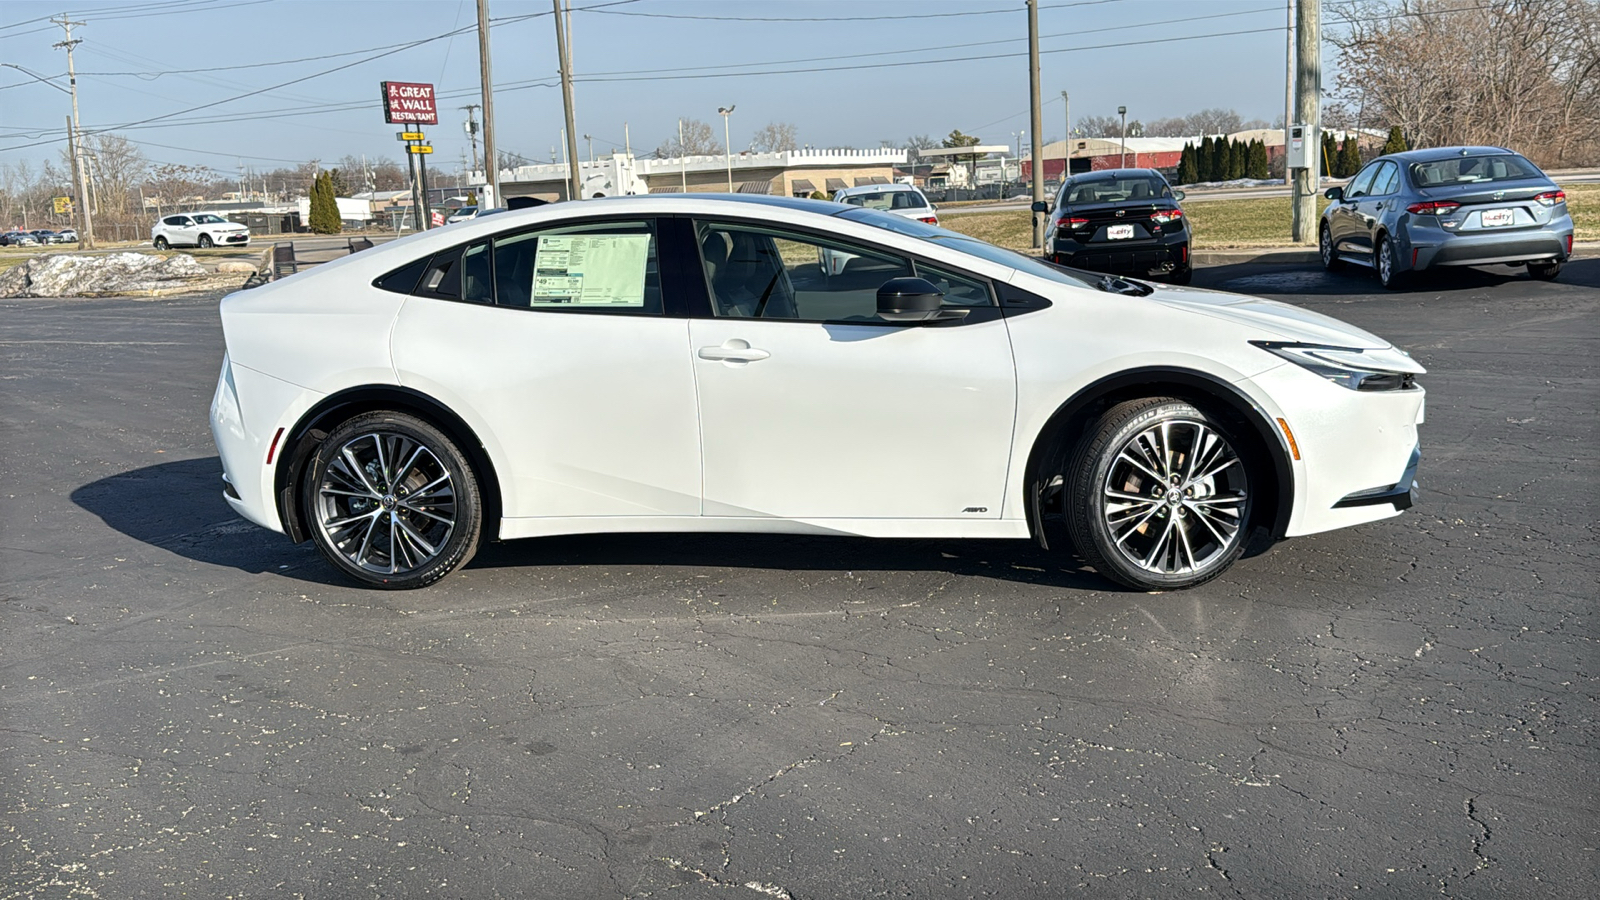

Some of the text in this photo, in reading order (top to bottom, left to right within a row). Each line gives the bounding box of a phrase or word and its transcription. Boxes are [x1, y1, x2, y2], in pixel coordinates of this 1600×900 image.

[399, 86, 432, 98] GREAT
[401, 99, 433, 110] WALL
[391, 111, 436, 121] RESTAURANT
